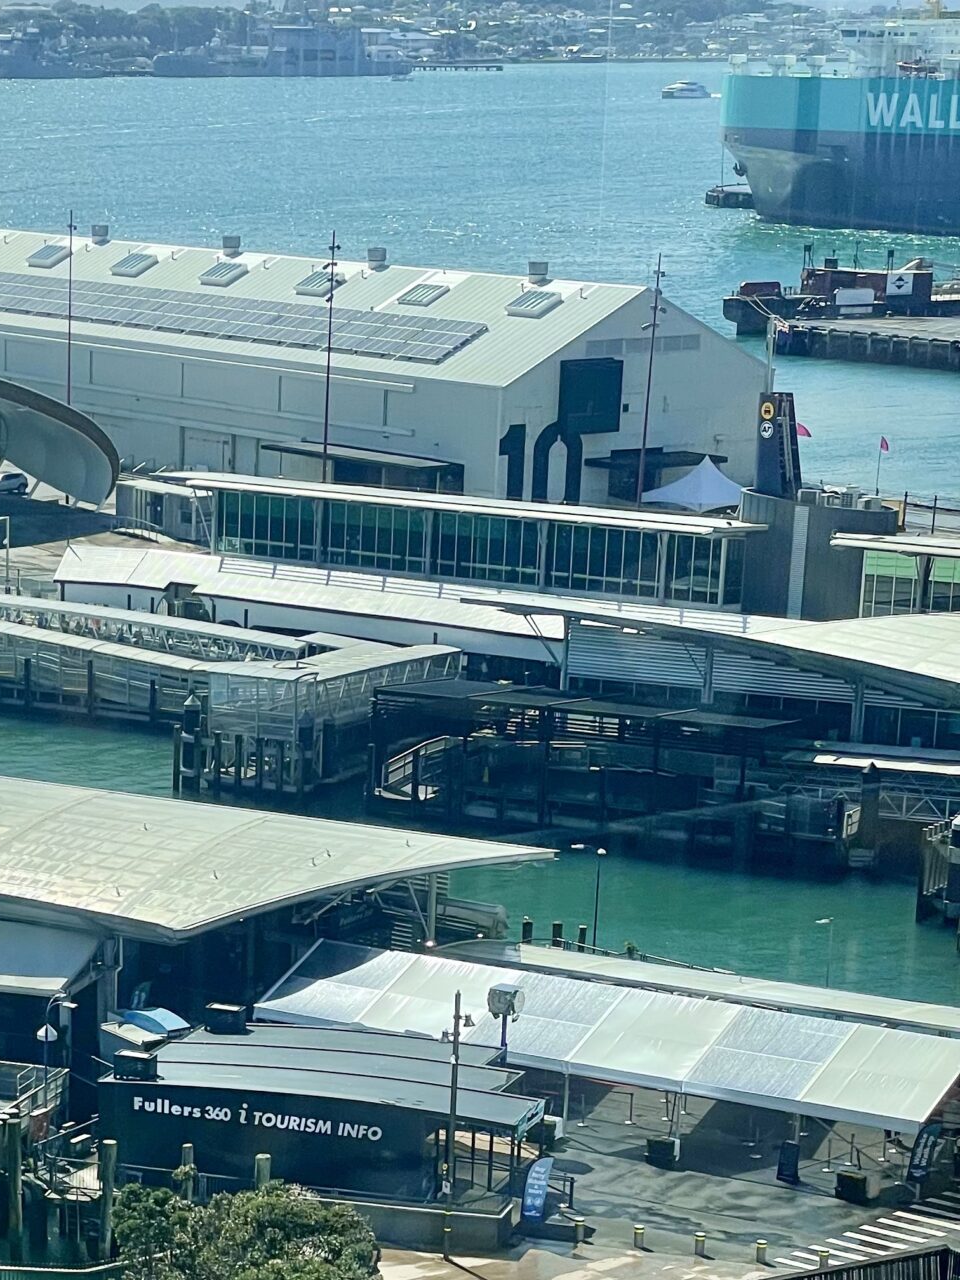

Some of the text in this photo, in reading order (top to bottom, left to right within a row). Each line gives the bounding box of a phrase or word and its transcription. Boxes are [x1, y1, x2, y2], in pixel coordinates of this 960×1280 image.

[867, 93, 960, 129] WALL
[499, 420, 583, 505] 10
[133, 1096, 202, 1118] Fullers
[204, 1105, 232, 1122] 360
[253, 1111, 332, 1135] TOURISM
[337, 1122, 383, 1141] INFO
